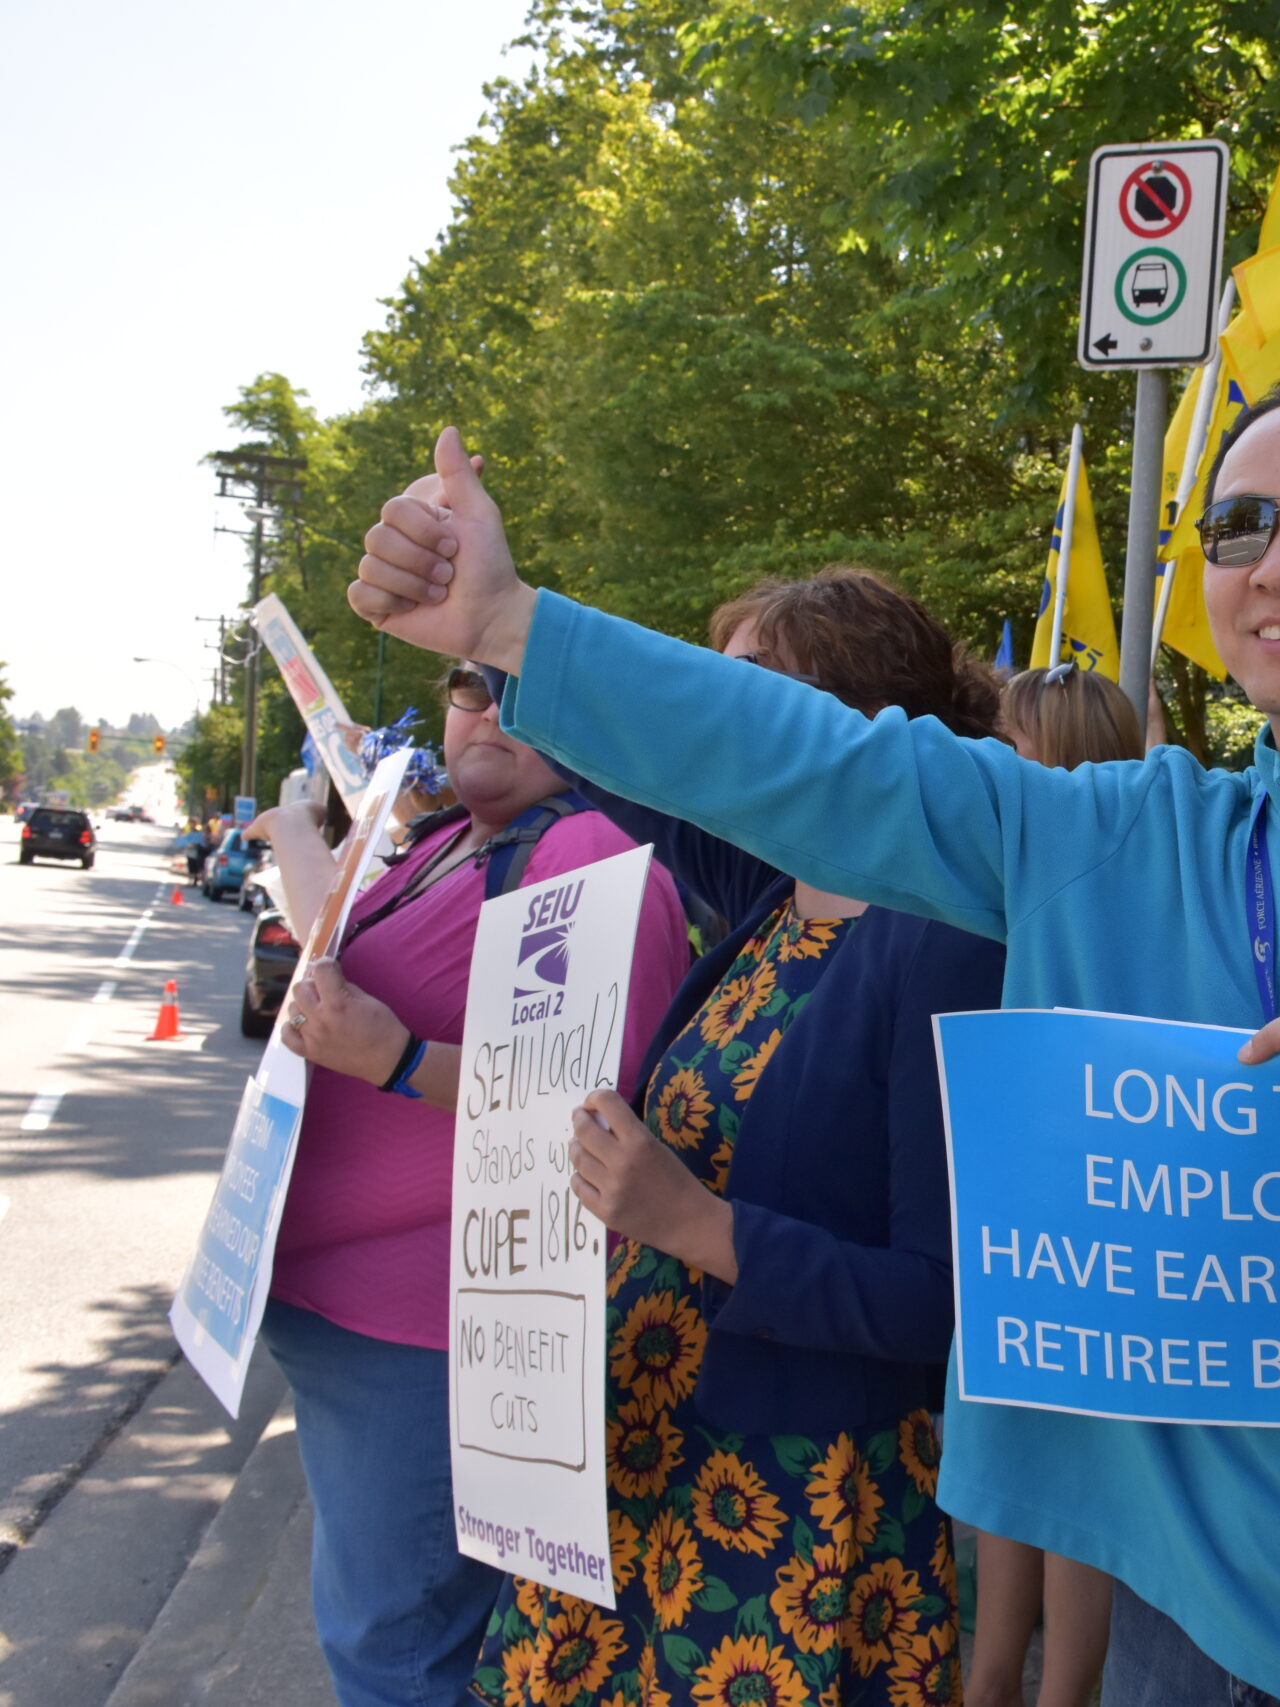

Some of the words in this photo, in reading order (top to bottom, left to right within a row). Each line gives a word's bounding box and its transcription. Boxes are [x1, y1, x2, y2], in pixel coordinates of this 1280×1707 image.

[522, 879, 585, 933] SEIU
[511, 994, 551, 1026] Local
[553, 991, 564, 1016] 2
[467, 1035, 534, 1121] SEIU
[595, 982, 618, 1088] 2
[1084, 1063, 1258, 1136] LONG
[466, 1128, 535, 1185] Stands
[463, 1207, 530, 1280] CUPE
[981, 1226, 1136, 1296] HAVE
[461, 1315, 485, 1369] NO
[495, 1320, 569, 1377] BENEFIT
[998, 1316, 1231, 1388] RETIREE
[458, 1505, 521, 1558] Stronger
[525, 1526, 605, 1582] Together
